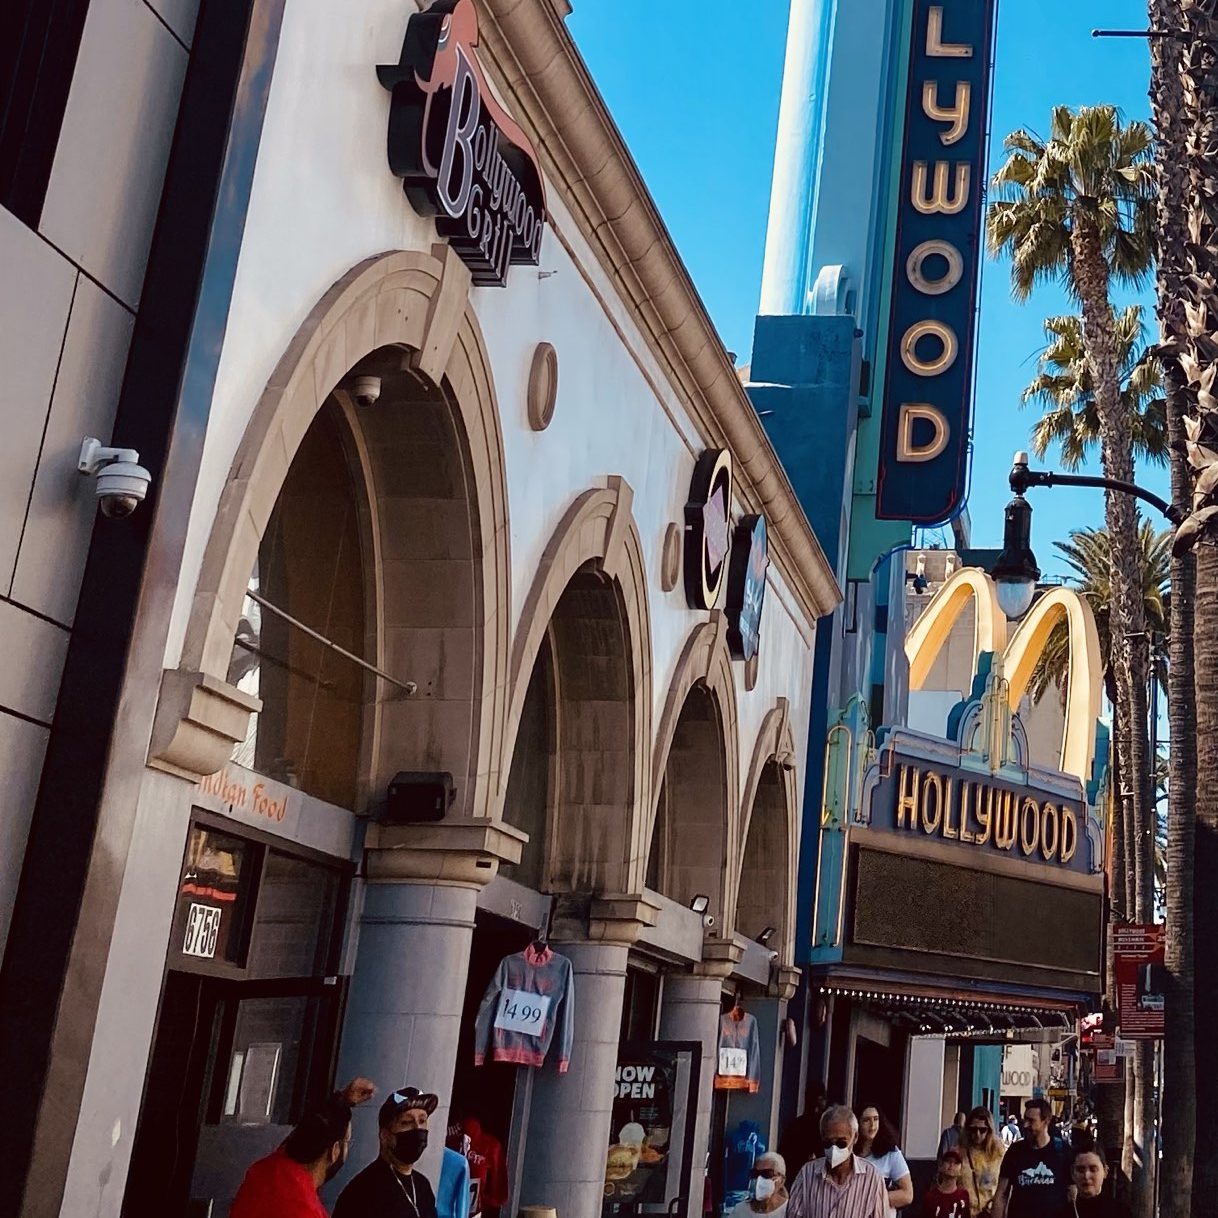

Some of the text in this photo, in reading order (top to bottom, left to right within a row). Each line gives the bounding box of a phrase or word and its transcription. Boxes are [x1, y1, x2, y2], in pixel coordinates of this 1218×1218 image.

[253, 782, 288, 822] Food
[897, 763, 1078, 863] HOLLYWOOD
[185, 905, 220, 957] 6756
